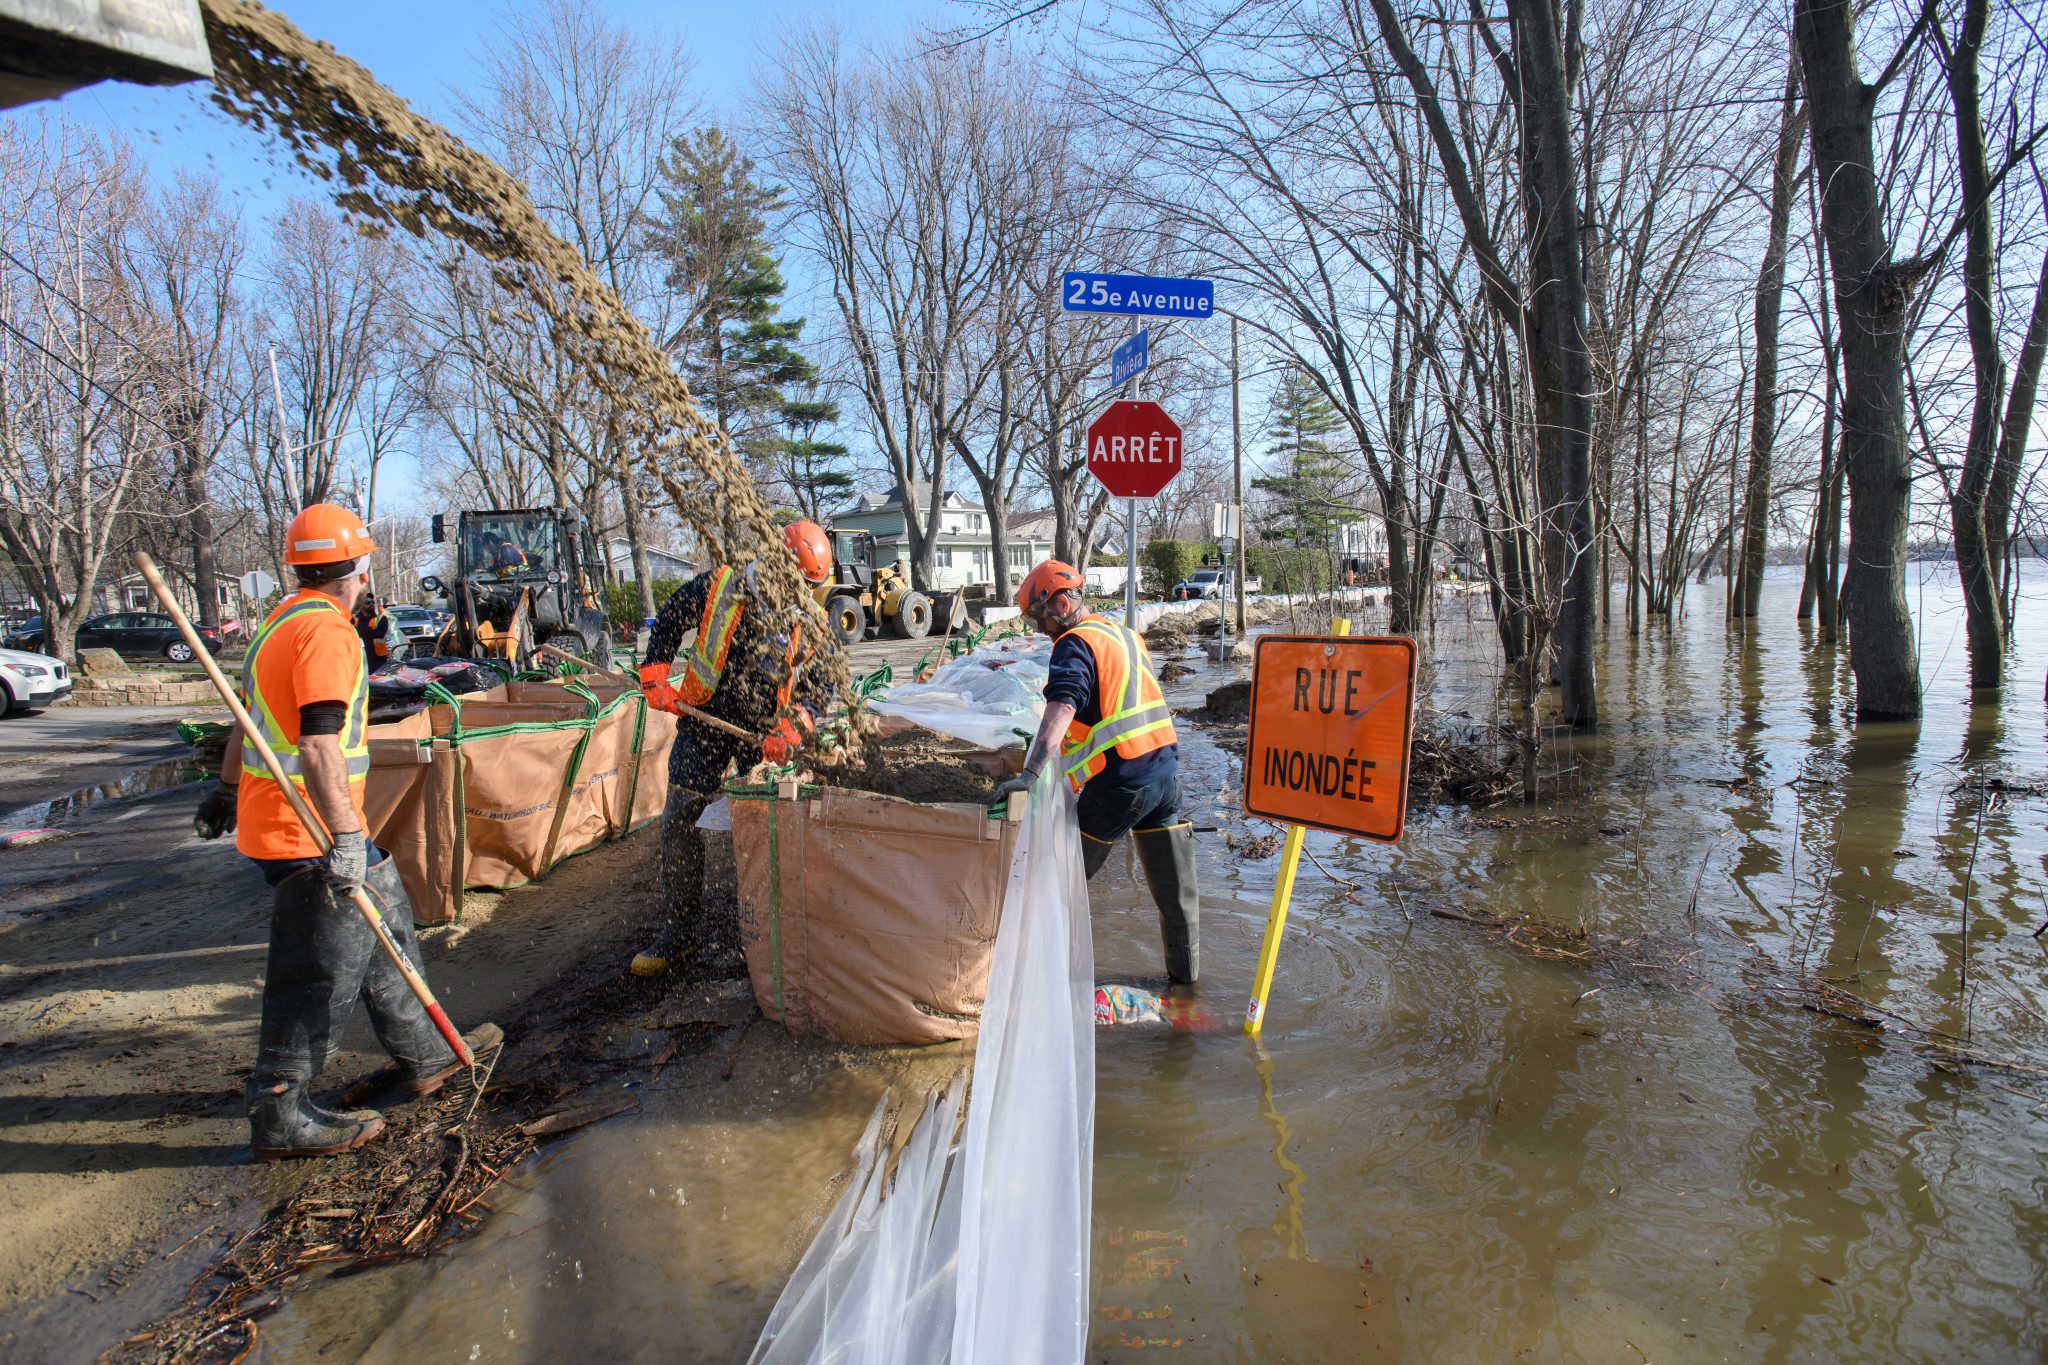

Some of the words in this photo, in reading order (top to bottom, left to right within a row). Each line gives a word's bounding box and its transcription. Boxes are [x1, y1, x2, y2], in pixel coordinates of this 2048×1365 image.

[1068, 279, 1122, 307] 25e
[1127, 290, 1209, 312] Avenue
[1115, 352, 1143, 383] Riviera
[1092, 431, 1178, 464] ARRÊT
[1293, 667, 1362, 716] RUE
[1264, 747, 1376, 803] INONDÉE
